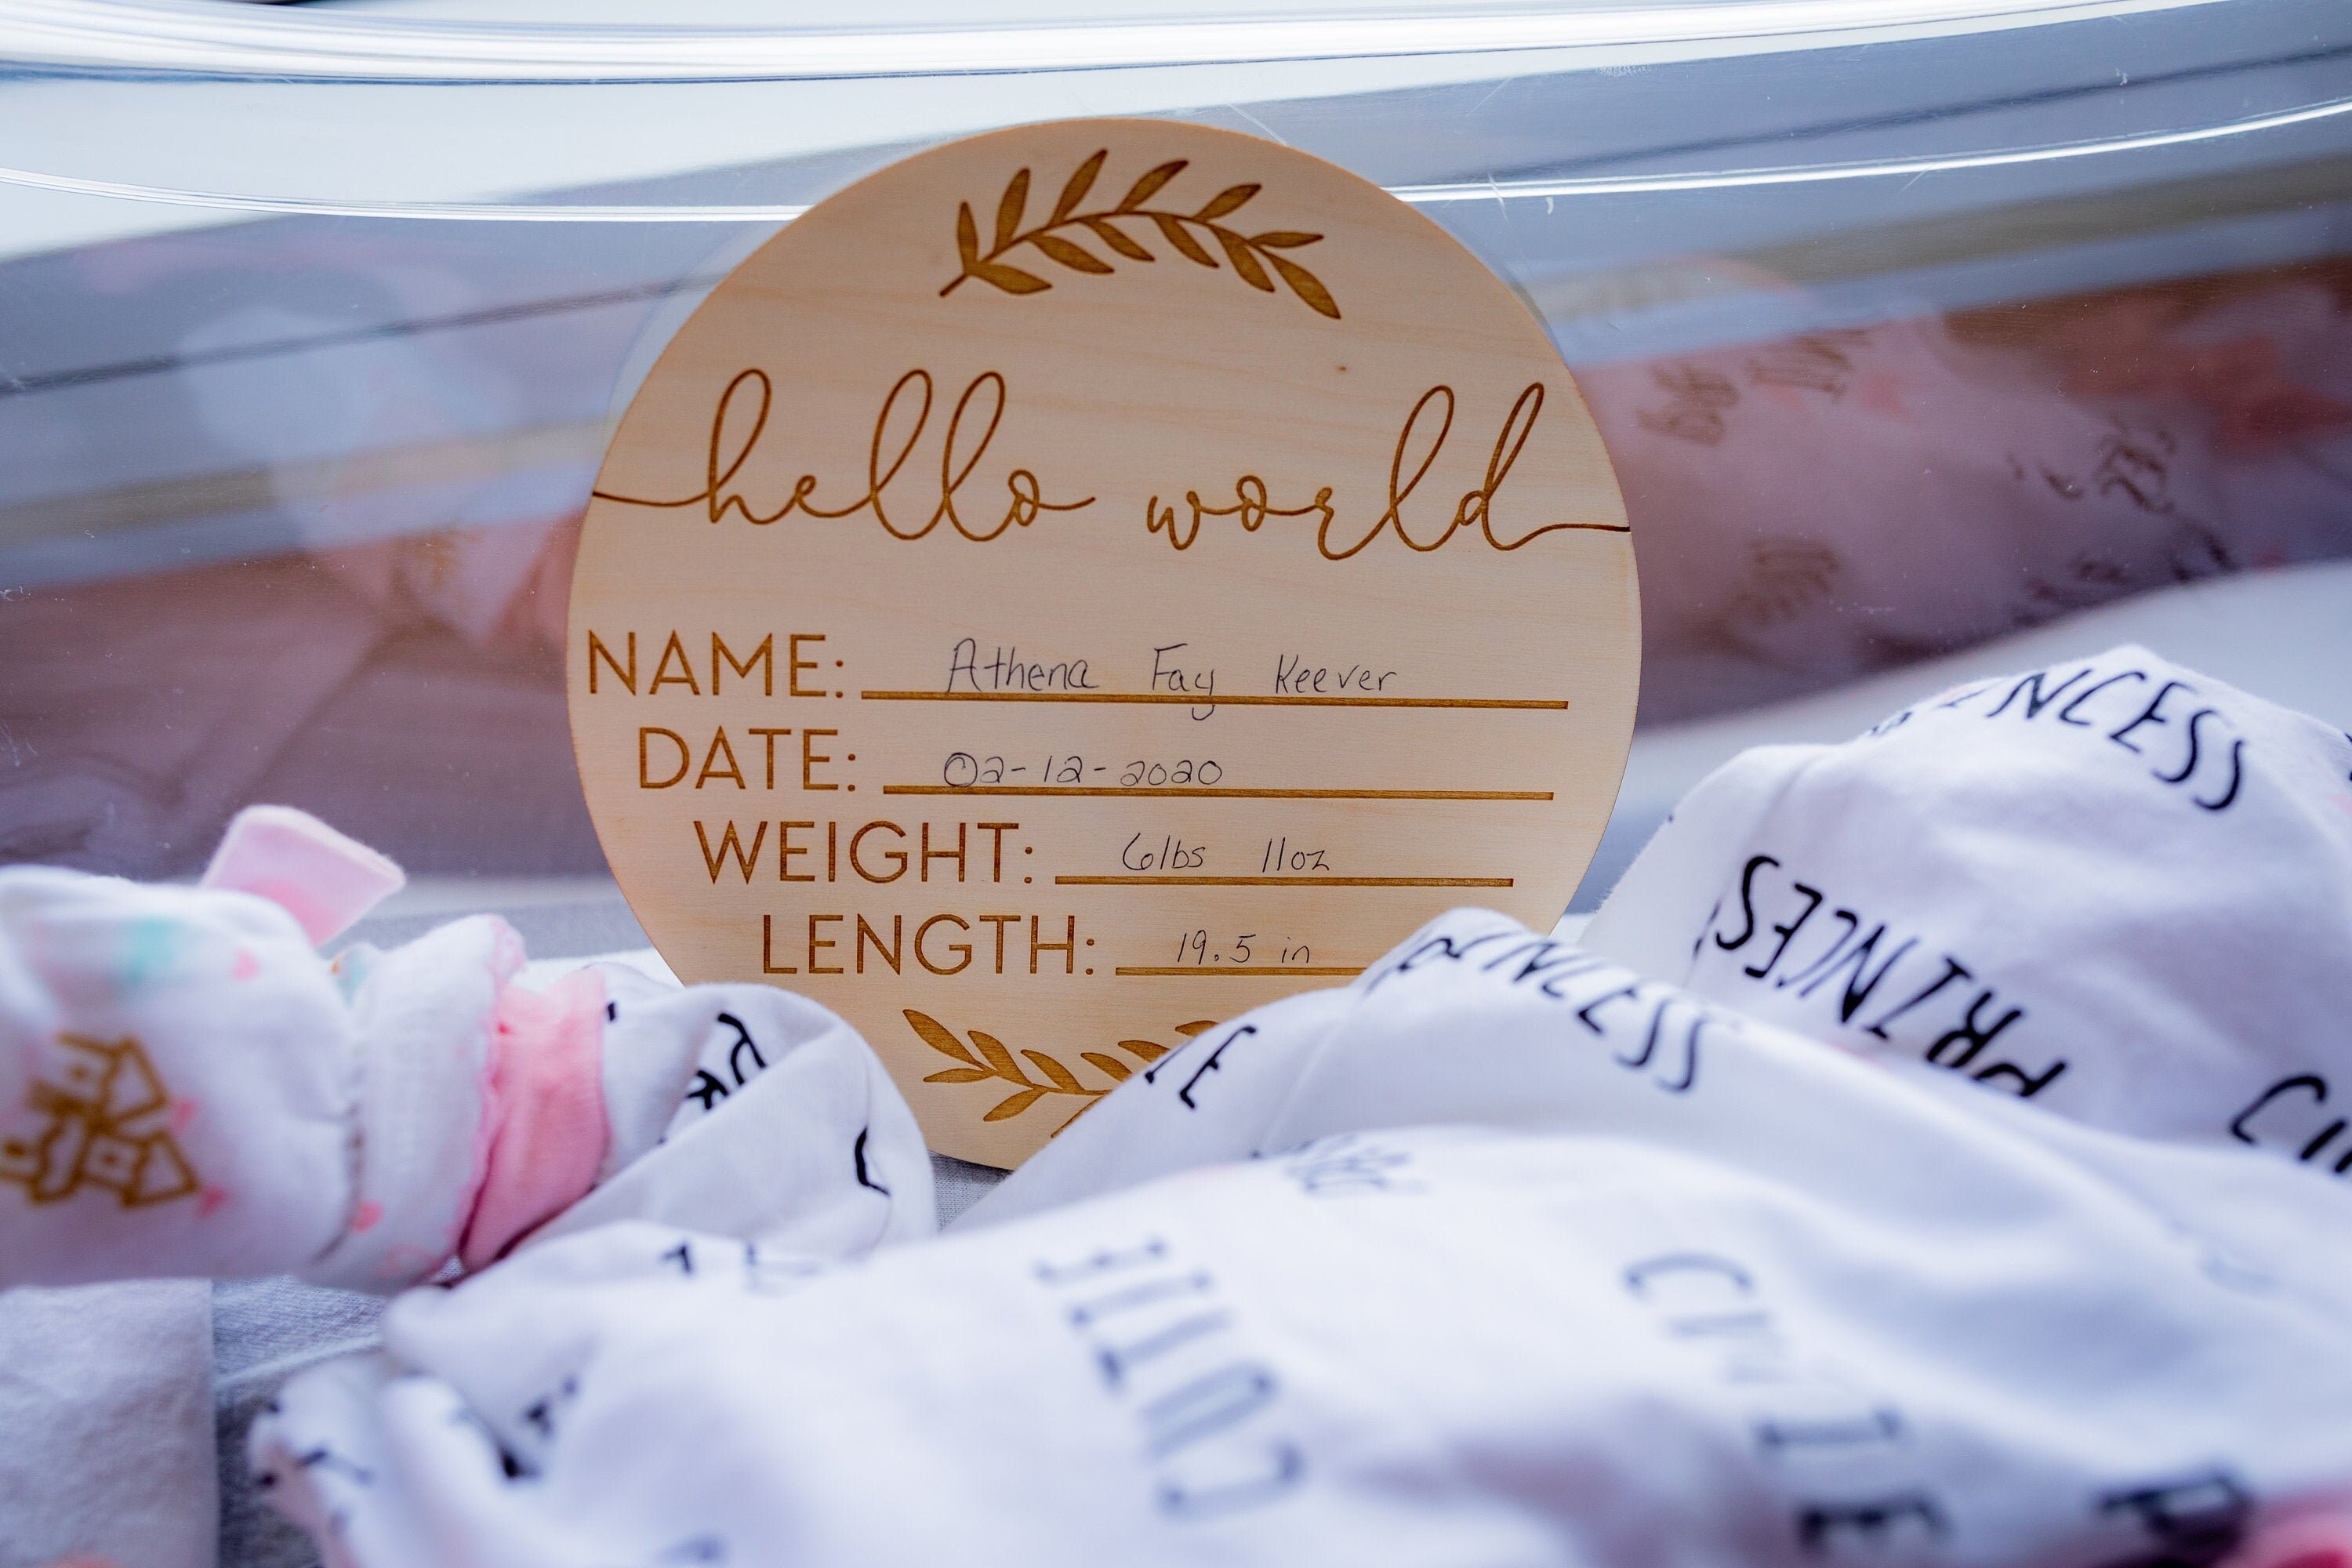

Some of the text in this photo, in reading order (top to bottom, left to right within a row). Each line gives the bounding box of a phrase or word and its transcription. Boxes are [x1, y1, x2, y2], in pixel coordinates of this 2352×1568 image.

[592, 368, 1096, 542] hello
[1146, 382, 1631, 561] world
[588, 630, 844, 699] NAME:
[945, 637, 1398, 721] Athena Fay Keever
[638, 725, 857, 793] DATE:
[943, 752, 1223, 787] 02-12-2020
[693, 819, 1033, 884] WEIGHT:
[1122, 832, 1330, 873] 6lbs 11oz
[763, 913, 1096, 976] LENGTH:
[1176, 929, 1311, 965] 19.5 in
[1690, 855, 2068, 1098] PRINCES
